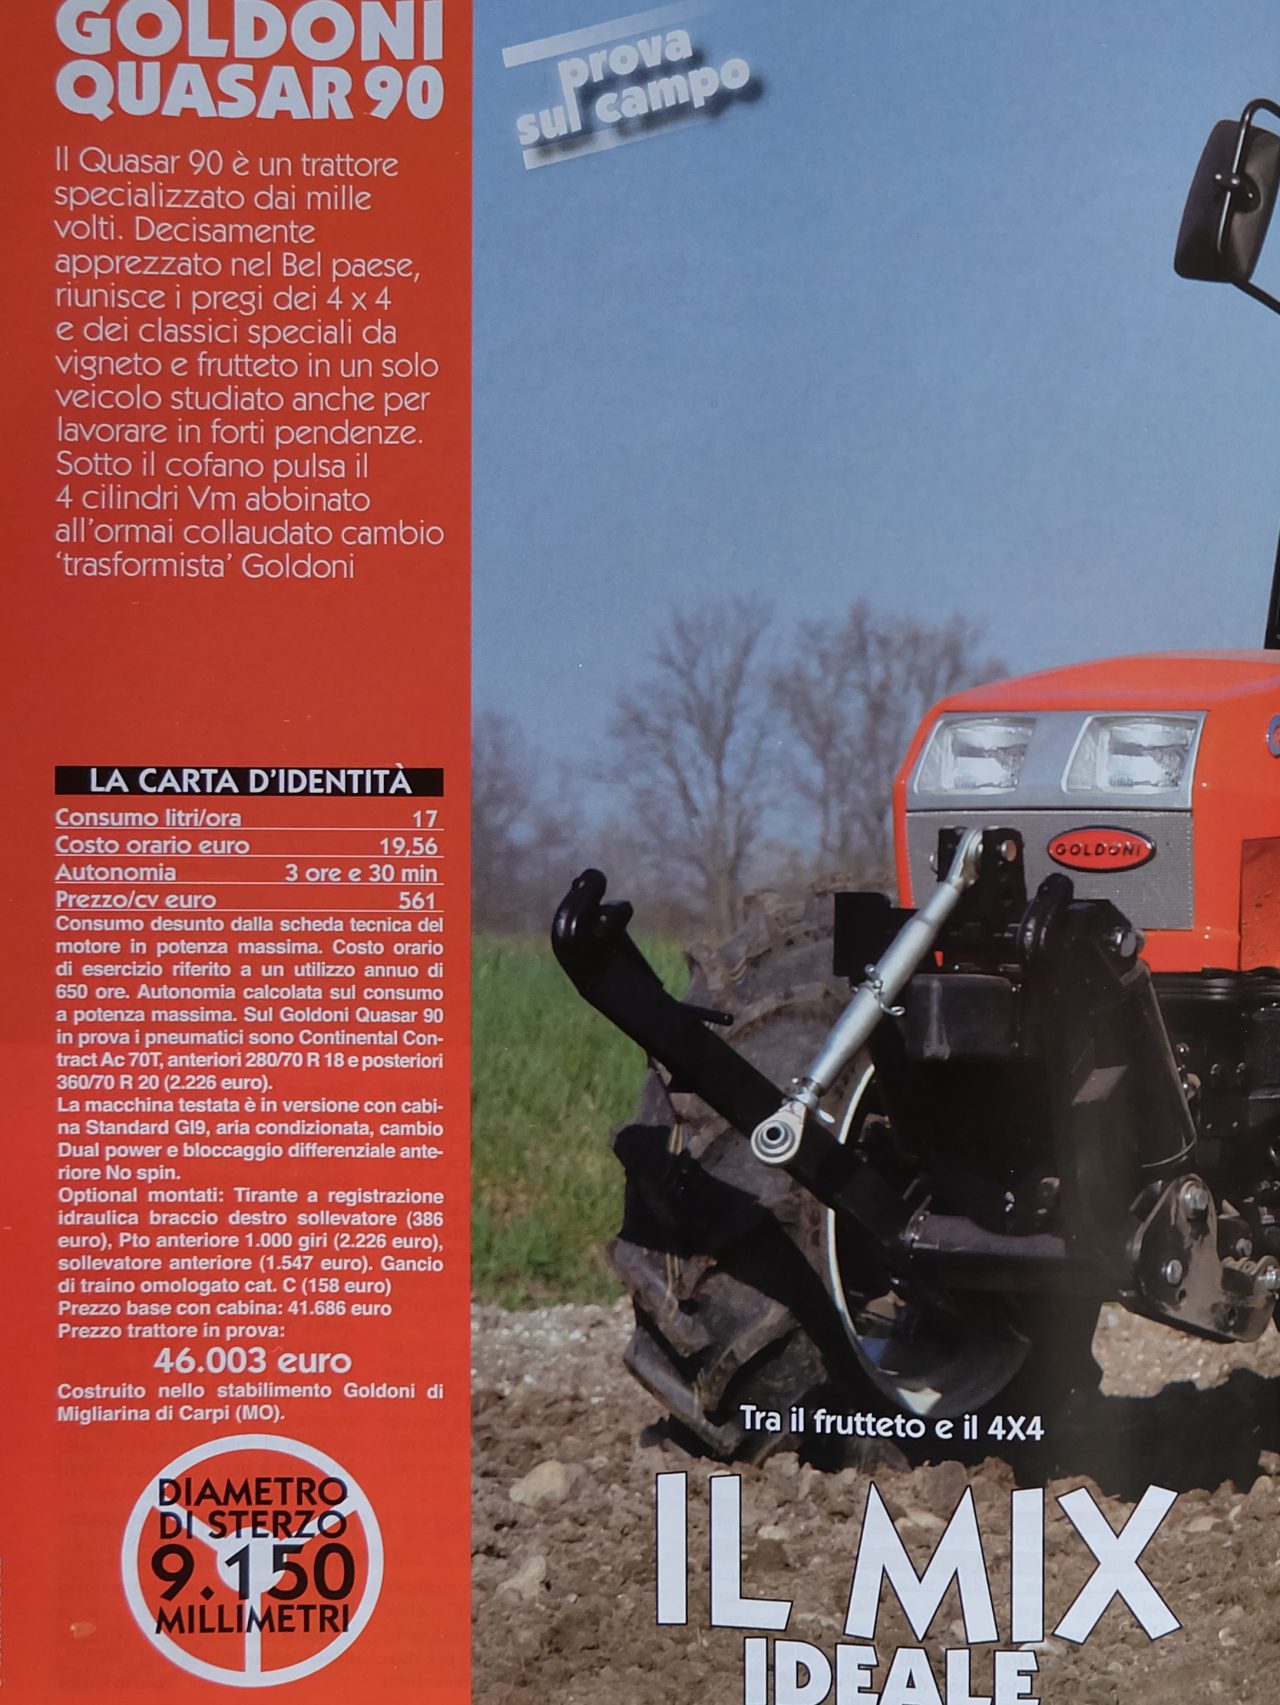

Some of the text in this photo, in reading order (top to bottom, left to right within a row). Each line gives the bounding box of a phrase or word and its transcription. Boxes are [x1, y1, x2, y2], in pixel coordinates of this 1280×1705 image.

[55, 0, 444, 61] GOLDONI
[557, 28, 693, 114] prova
[55, 59, 444, 121] QUASAR 90
[516, 58, 750, 146] sul campo
[57, 146, 398, 177] Il Quasar 90 è un trattore
[55, 182, 371, 211] specializzato dai mille
[54, 214, 315, 243] volti. Decisamente
[56, 251, 420, 283] apprezzato nel Bel paese,
[56, 316, 396, 349] e dei classici speciali da
[56, 350, 439, 381] vigneto e frutteto in un solo
[90, 763, 412, 795] LA CARTA D'IDENTITÀ
[55, 809, 438, 828] Consumo litri/ora 17
[55, 836, 438, 857] Costo orario euro 19,56
[1055, 843, 1141, 856] GOLDONI
[55, 864, 437, 882] Autonomia 3 ore e 30 min
[56, 891, 436, 910] Prezzo/cv euro 561
[56, 916, 443, 932] Consumo desunto dalla scheda tecnica del
[59, 1300, 392, 1316] Prezzo base con cabina: 41.686 euro
[154, 1347, 352, 1374] 46.003 euro
[58, 1382, 443, 1399] Costruito nello stabilimento Goldoni di
[58, 1404, 285, 1425] Migliarina di Carpi (MO).
[740, 1405, 1044, 1442] Tra il frutteto e il 4X4
[159, 1477, 348, 1506] DIAMETRO
[161, 1510, 347, 1539] DI STERZO
[151, 1543, 355, 1601] 9.150
[656, 1472, 1182, 1644] IL MIX
[155, 1604, 349, 1634] MILLIMETRI
[743, 1636, 1040, 1705] IDEALE
